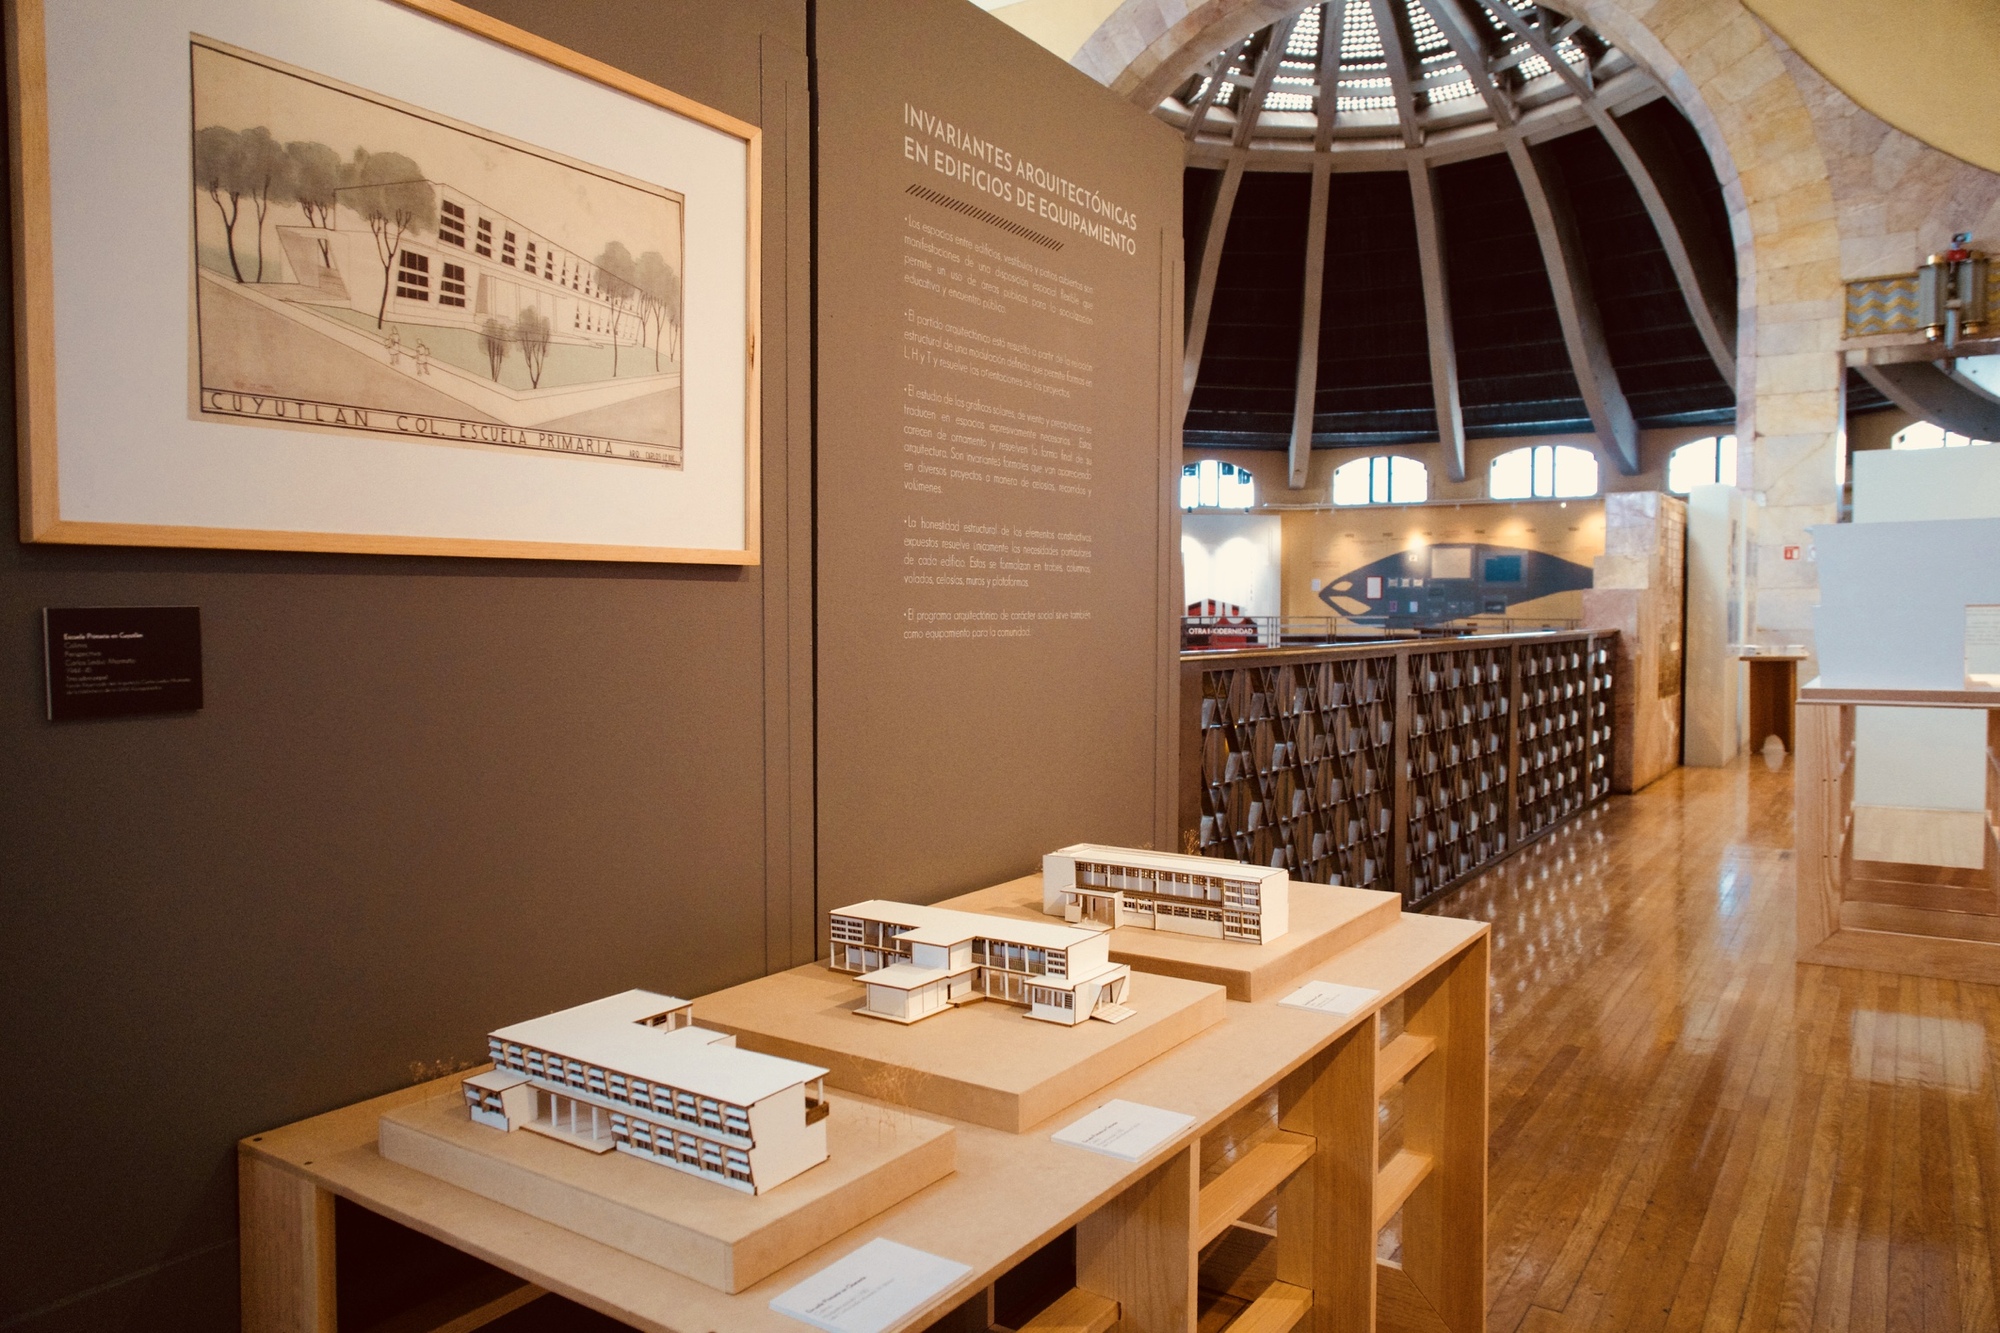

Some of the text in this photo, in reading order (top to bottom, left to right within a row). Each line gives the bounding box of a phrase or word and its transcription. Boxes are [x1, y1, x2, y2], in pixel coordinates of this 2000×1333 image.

[904, 102, 1137, 231] INVARIANTES ARQUITECTÓNICAS
[904, 136, 1136, 256] EN EDIFICIOS DE EQUIPAMIENTO
[908, 215, 920, 229] Los
[922, 224, 953, 242] espacios
[955, 236, 973, 249] entre
[905, 235, 960, 263] manifestaciones
[965, 255, 974, 267] de
[905, 273, 941, 292] educativa
[942, 287, 947, 296] y
[937, 266, 946, 275] un
[951, 272, 962, 281] uso
[967, 275, 976, 286] de
[908, 309, 914, 322] El
[917, 315, 943, 331] partido
[904, 329, 942, 348] estructural
[943, 338, 953, 351] de
[955, 344, 968, 354] una
[904, 346, 910, 360] L,
[911, 347, 918, 359] H
[920, 353, 925, 365] y
[926, 351, 932, 363] T
[933, 357, 938, 367] y
[940, 357, 968, 373] resuelve
[970, 364, 979, 376] las
[908, 384, 914, 397] El
[916, 389, 942, 403] estudio
[944, 392, 954, 405] de
[955, 395, 964, 408] las
[904, 405, 936, 420] traducen
[942, 414, 950, 422] en
[210, 392, 369, 428] CUYUTLAN
[460, 423, 528, 446] ESCUELA
[539, 433, 614, 456] PRIMARIA
[904, 425, 932, 438] carecen
[937, 428, 946, 440] de
[951, 447, 964, 460] Son
[904, 462, 913, 471] en
[918, 461, 946, 476] diversos
[904, 478, 942, 494] volúmenes.
[921, 516, 960, 532] honestidad
[904, 537, 938, 548] expuestos
[942, 537, 969, 550] resuelve
[904, 554, 914, 566] de
[918, 554, 937, 566] cada
[904, 572, 934, 585] volados,
[908, 608, 913, 620] El
[917, 612, 951, 624] programa
[904, 631, 923, 639] como
[926, 628, 970, 641] equipamiento
